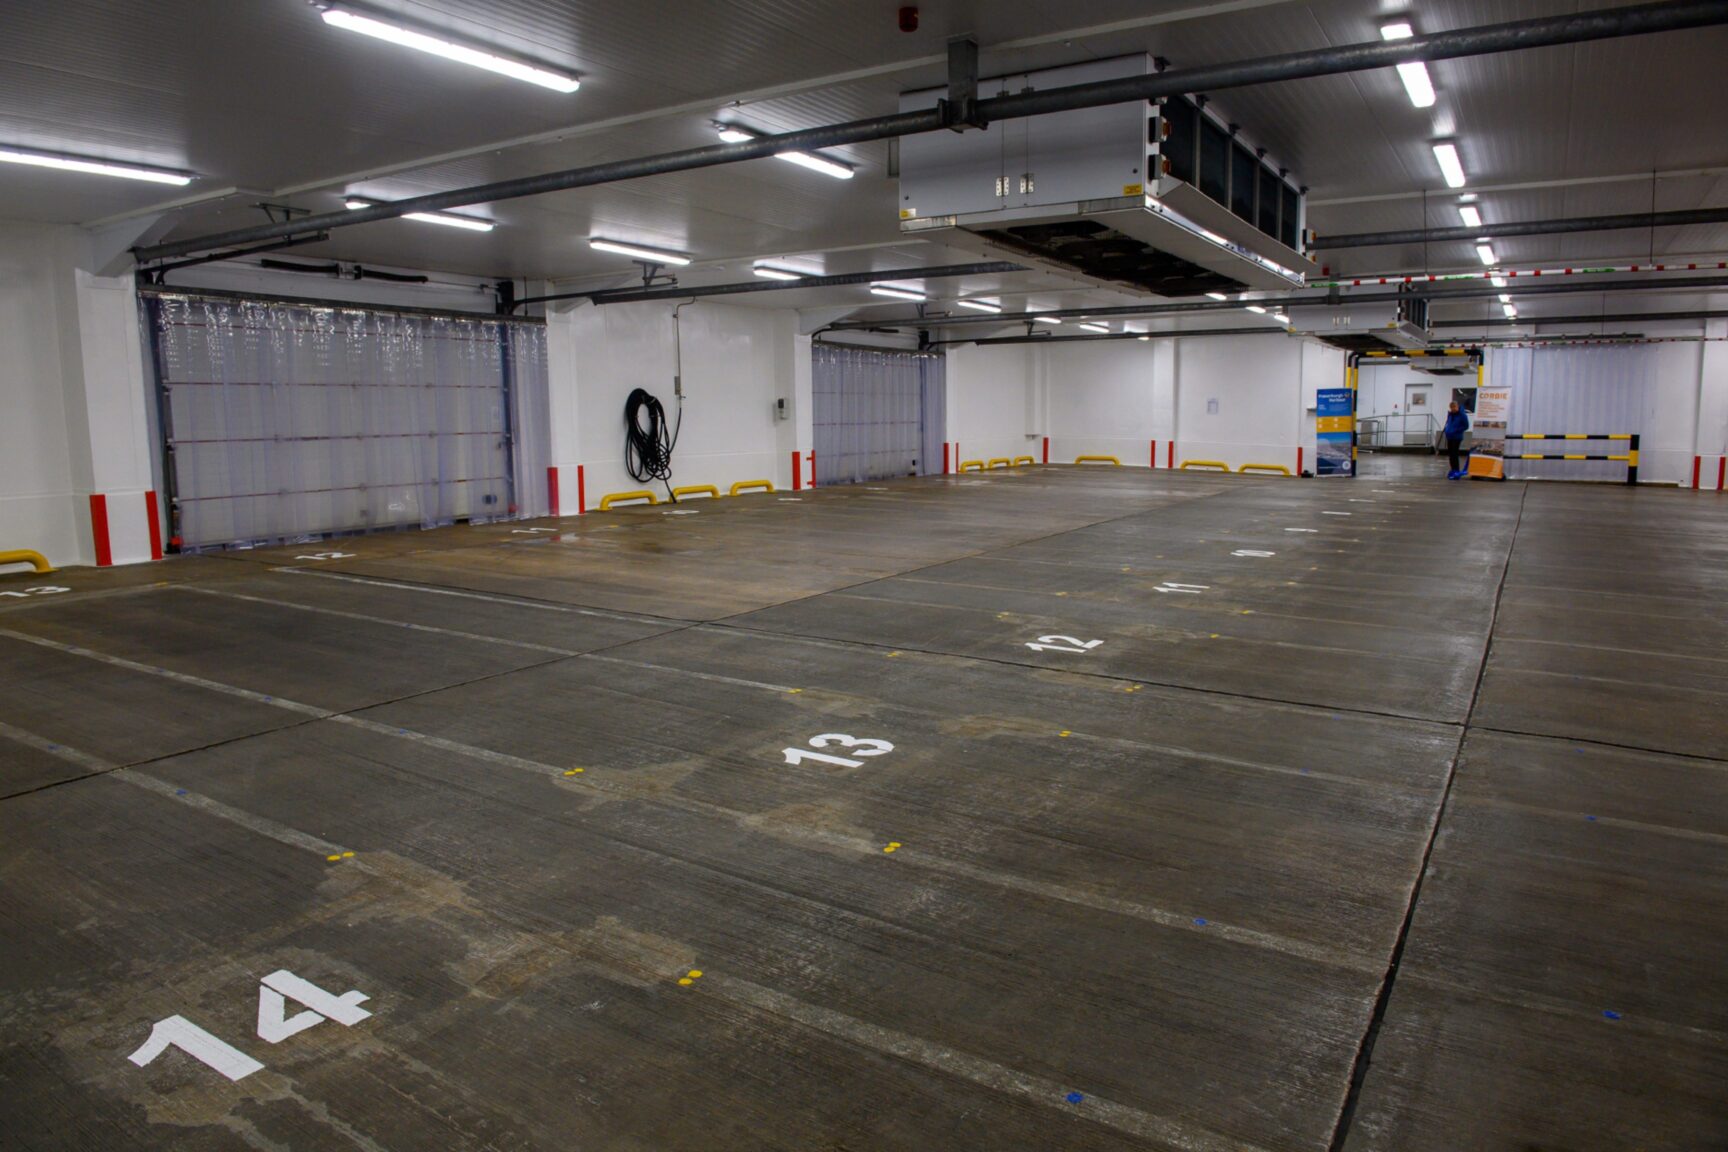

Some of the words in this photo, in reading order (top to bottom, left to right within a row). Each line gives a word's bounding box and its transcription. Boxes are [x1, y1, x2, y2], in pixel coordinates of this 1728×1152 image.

[294, 551, 356, 562] 12
[1230, 549, 1277, 558] 10
[0, 586, 71, 598] 13
[1152, 581, 1211, 594] 11
[1024, 634, 1105, 654] 12
[782, 732, 896, 769] 13
[127, 969, 373, 1081] 14
